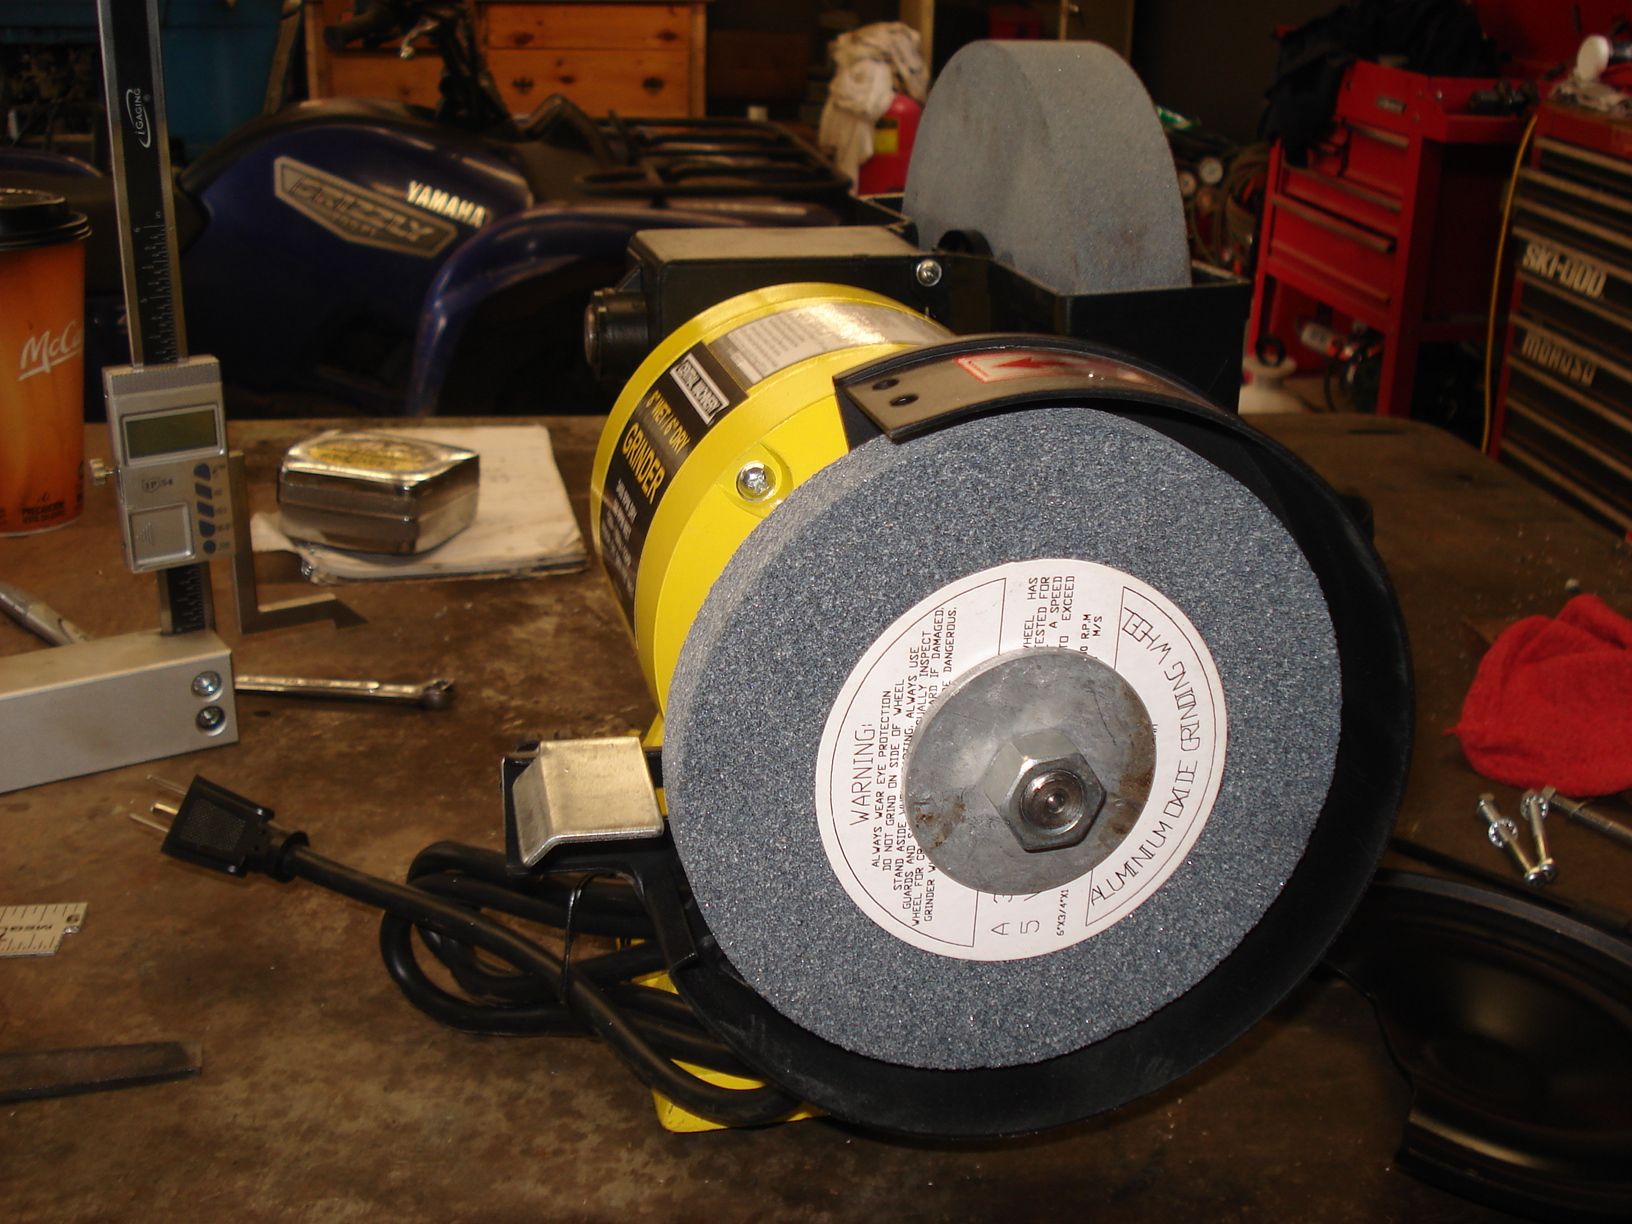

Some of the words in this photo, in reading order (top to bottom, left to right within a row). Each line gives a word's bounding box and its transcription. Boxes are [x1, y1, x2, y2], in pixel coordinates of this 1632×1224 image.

[407, 180, 486, 228] YAMAHA
[668, 425, 691, 455] DRY
[622, 422, 666, 505] GRINDER
[1027, 577, 1039, 600] HAS
[1038, 576, 1051, 600] FOR
[1050, 575, 1063, 614] SPEED
[1061, 575, 1075, 621] EXCEED
[1048, 621, 1058, 629] A
[1092, 615, 1103, 637] M/S
[1122, 606, 1172, 665] WHEEL
[909, 647, 920, 669] USE
[919, 631, 932, 678] INSPECT
[930, 667, 940, 679] IF
[893, 679, 905, 717] WHEEL
[906, 675, 917, 719] ALWAYS
[1164, 661, 1201, 752] GRINDING
[878, 690, 892, 758] PROTECTION
[891, 723, 901, 737] OF
[889, 743, 900, 768] SIDE
[849, 723, 876, 826] WARNING:
[876, 764, 887, 785] EYE
[888, 774, 898, 789] ON
[1164, 759, 1199, 820] OXIDE
[874, 791, 885, 820] WEAR
[885, 795, 896, 826] GRIND
[871, 826, 883, 868] ALWAYS
[884, 832, 894, 853] NOT
[896, 822, 907, 852] ASIDE
[883, 858, 892, 871] DO
[906, 845, 916, 865] AND
[1090, 820, 1175, 906] ALUMINIUM
[893, 858, 904, 891] STAND
[914, 866, 925, 887] FOR
[903, 871, 914, 910] GUARDS
[924, 879, 936, 922] GRINDER
[912, 893, 923, 927] WHEEL
[991, 922, 1011, 936] A
[1019, 919, 1040, 935] 5
